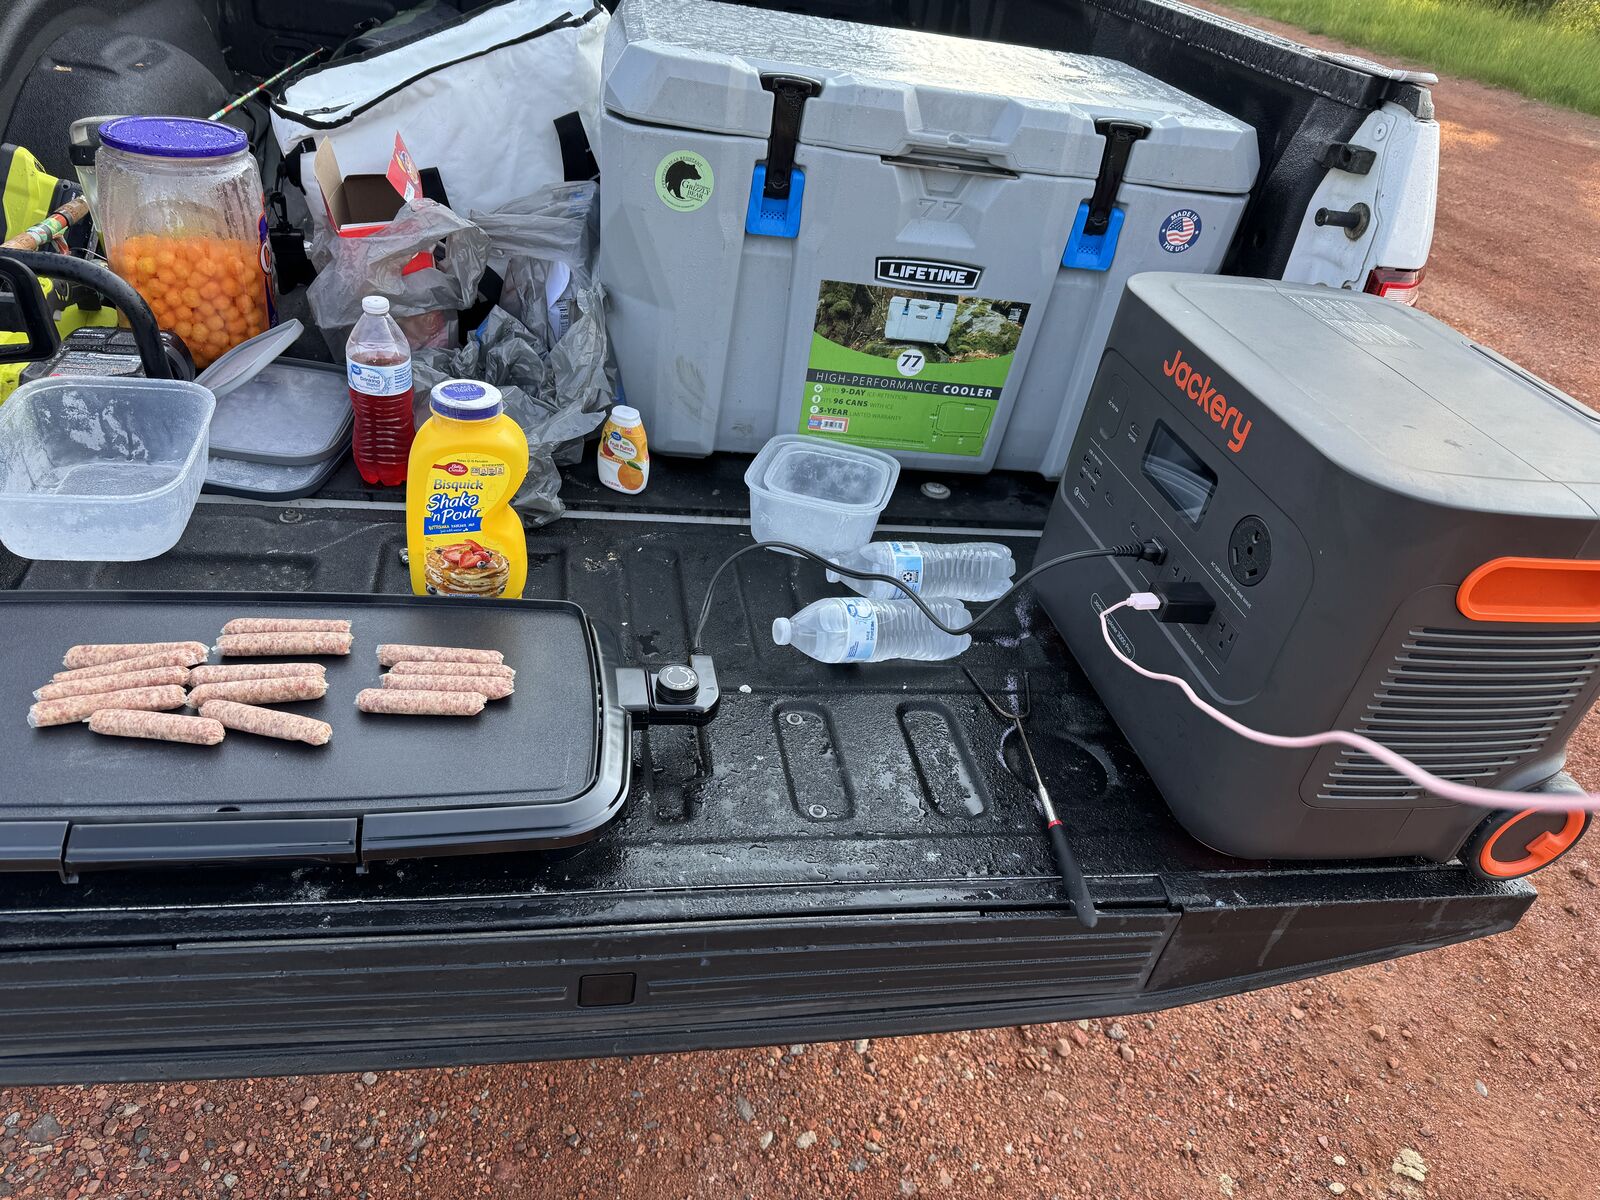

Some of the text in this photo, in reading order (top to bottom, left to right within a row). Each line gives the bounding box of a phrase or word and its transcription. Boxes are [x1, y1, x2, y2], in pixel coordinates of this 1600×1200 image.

[682, 181, 711, 195] GRIZZLY
[687, 190, 704, 199] BEAR
[1170, 210, 1199, 222] MADE IN
[1163, 241, 1189, 252] THE USA
[888, 263, 968, 284] LIFETIME
[901, 354, 923, 368] 77
[815, 372, 994, 398] HIGH-PERFORMANCE COOLER
[840, 388, 867, 397] 9-DAY
[833, 398, 844, 406] 96
[845, 399, 869, 408] CANS
[1163, 350, 1253, 453] Jackery
[819, 407, 849, 417] 5-YEAR
[609, 441, 620, 450] Fruit
[433, 479, 484, 493] Bisquick
[427, 492, 479, 512] Shake
[442, 508, 481, 524] Pour
